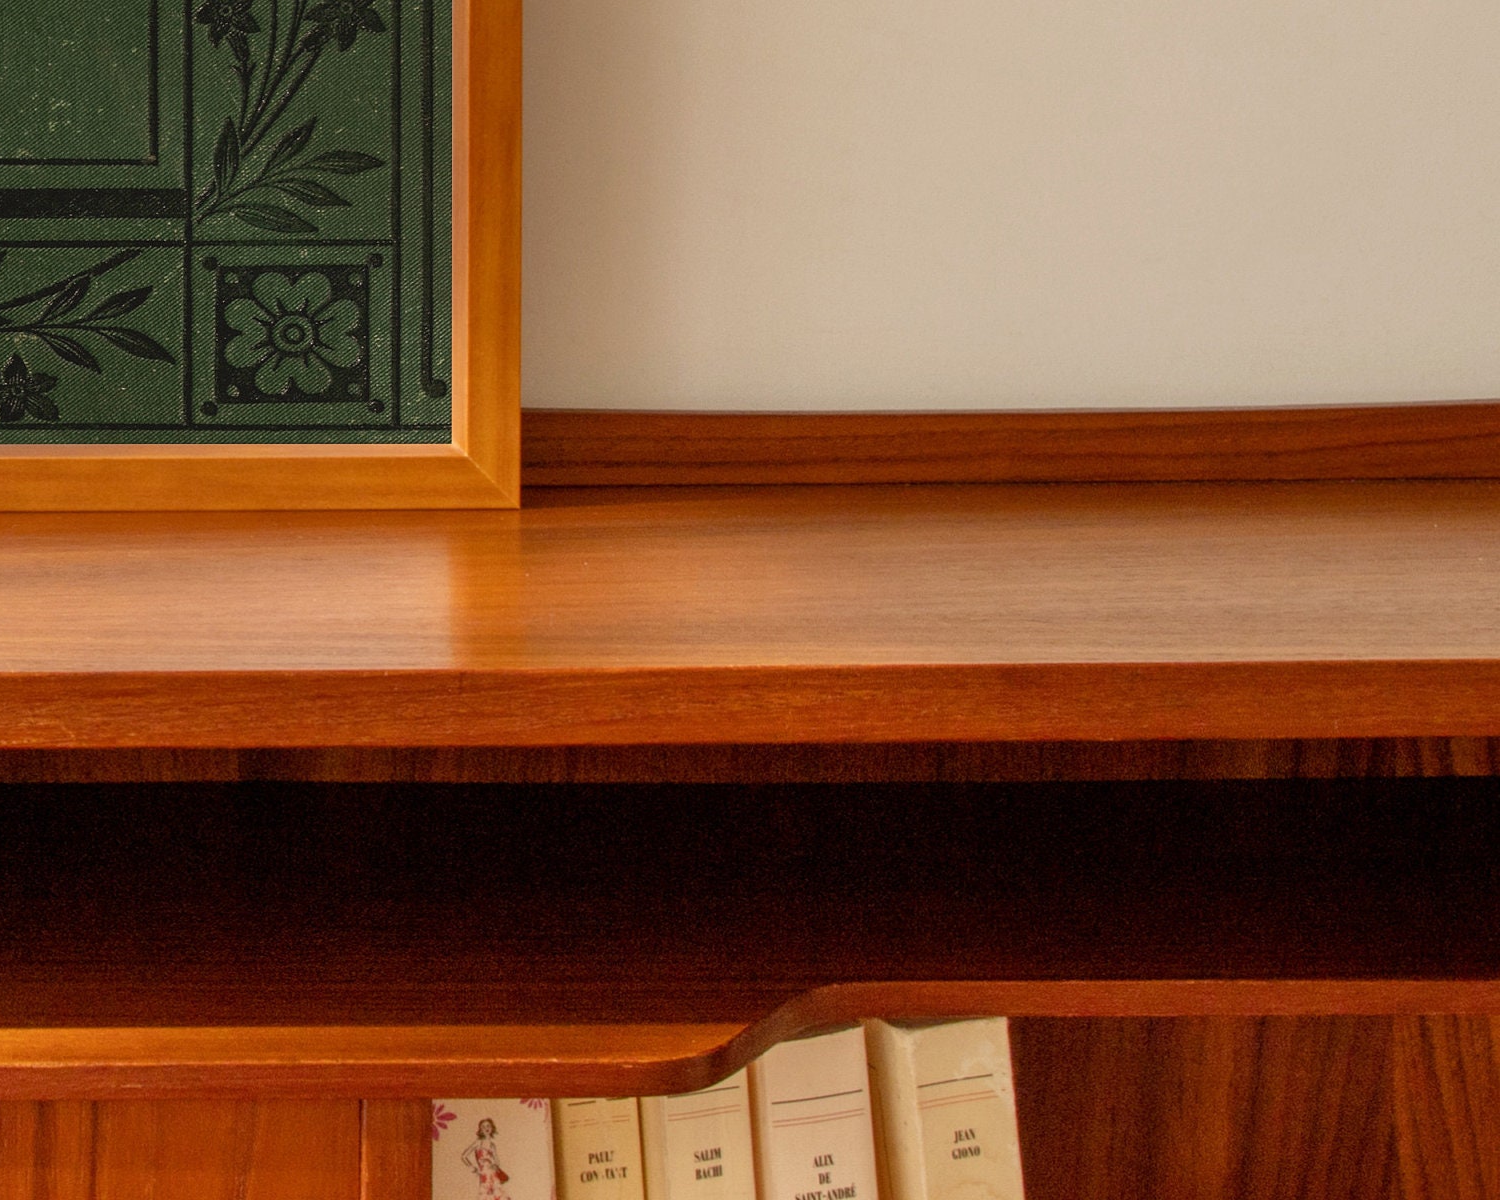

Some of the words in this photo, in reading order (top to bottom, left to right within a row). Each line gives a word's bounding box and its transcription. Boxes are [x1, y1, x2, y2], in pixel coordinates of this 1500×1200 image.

[953, 1128, 977, 1144] JEAN
[694, 1147, 721, 1163] SALIM
[952, 1145, 980, 1160] GIONO
[812, 1154, 834, 1168] ALIX
[580, 1166, 627, 1183] CONTAT
[695, 1165, 723, 1180] BACHI
[818, 1172, 831, 1185] DE
